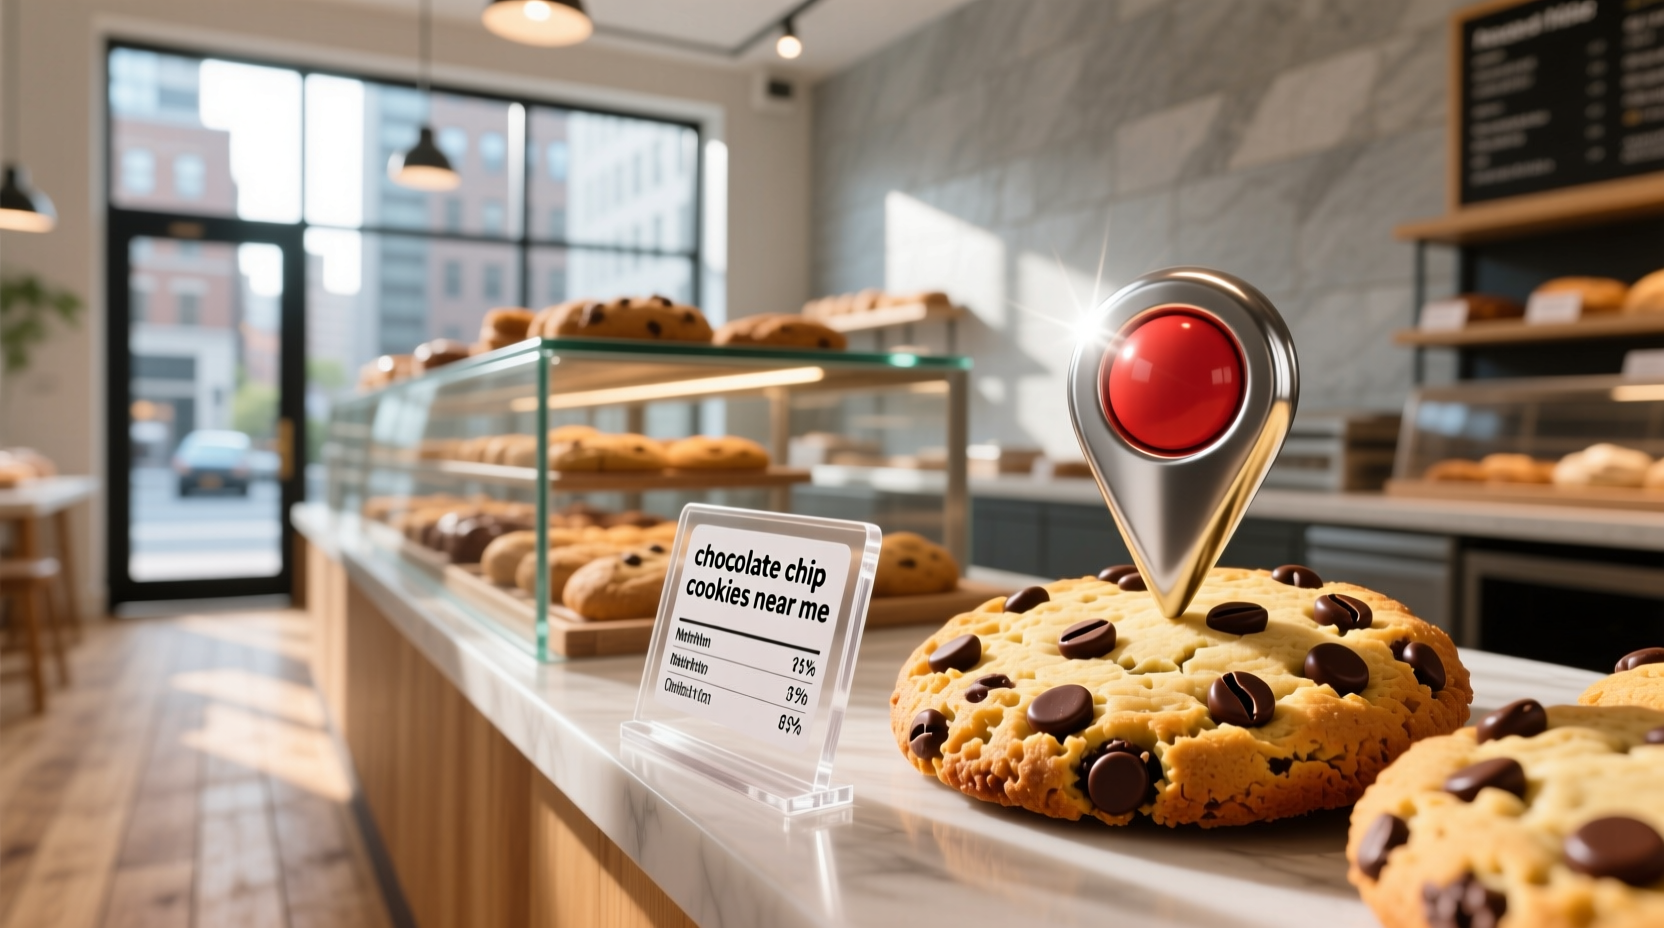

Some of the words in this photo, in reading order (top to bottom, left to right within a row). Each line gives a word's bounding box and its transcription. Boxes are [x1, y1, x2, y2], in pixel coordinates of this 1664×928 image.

[694, 543, 781, 579] chocolate
[785, 557, 826, 594] chip
[686, 577, 751, 607] cookies
[753, 590, 797, 616] near
[798, 599, 830, 623] me
